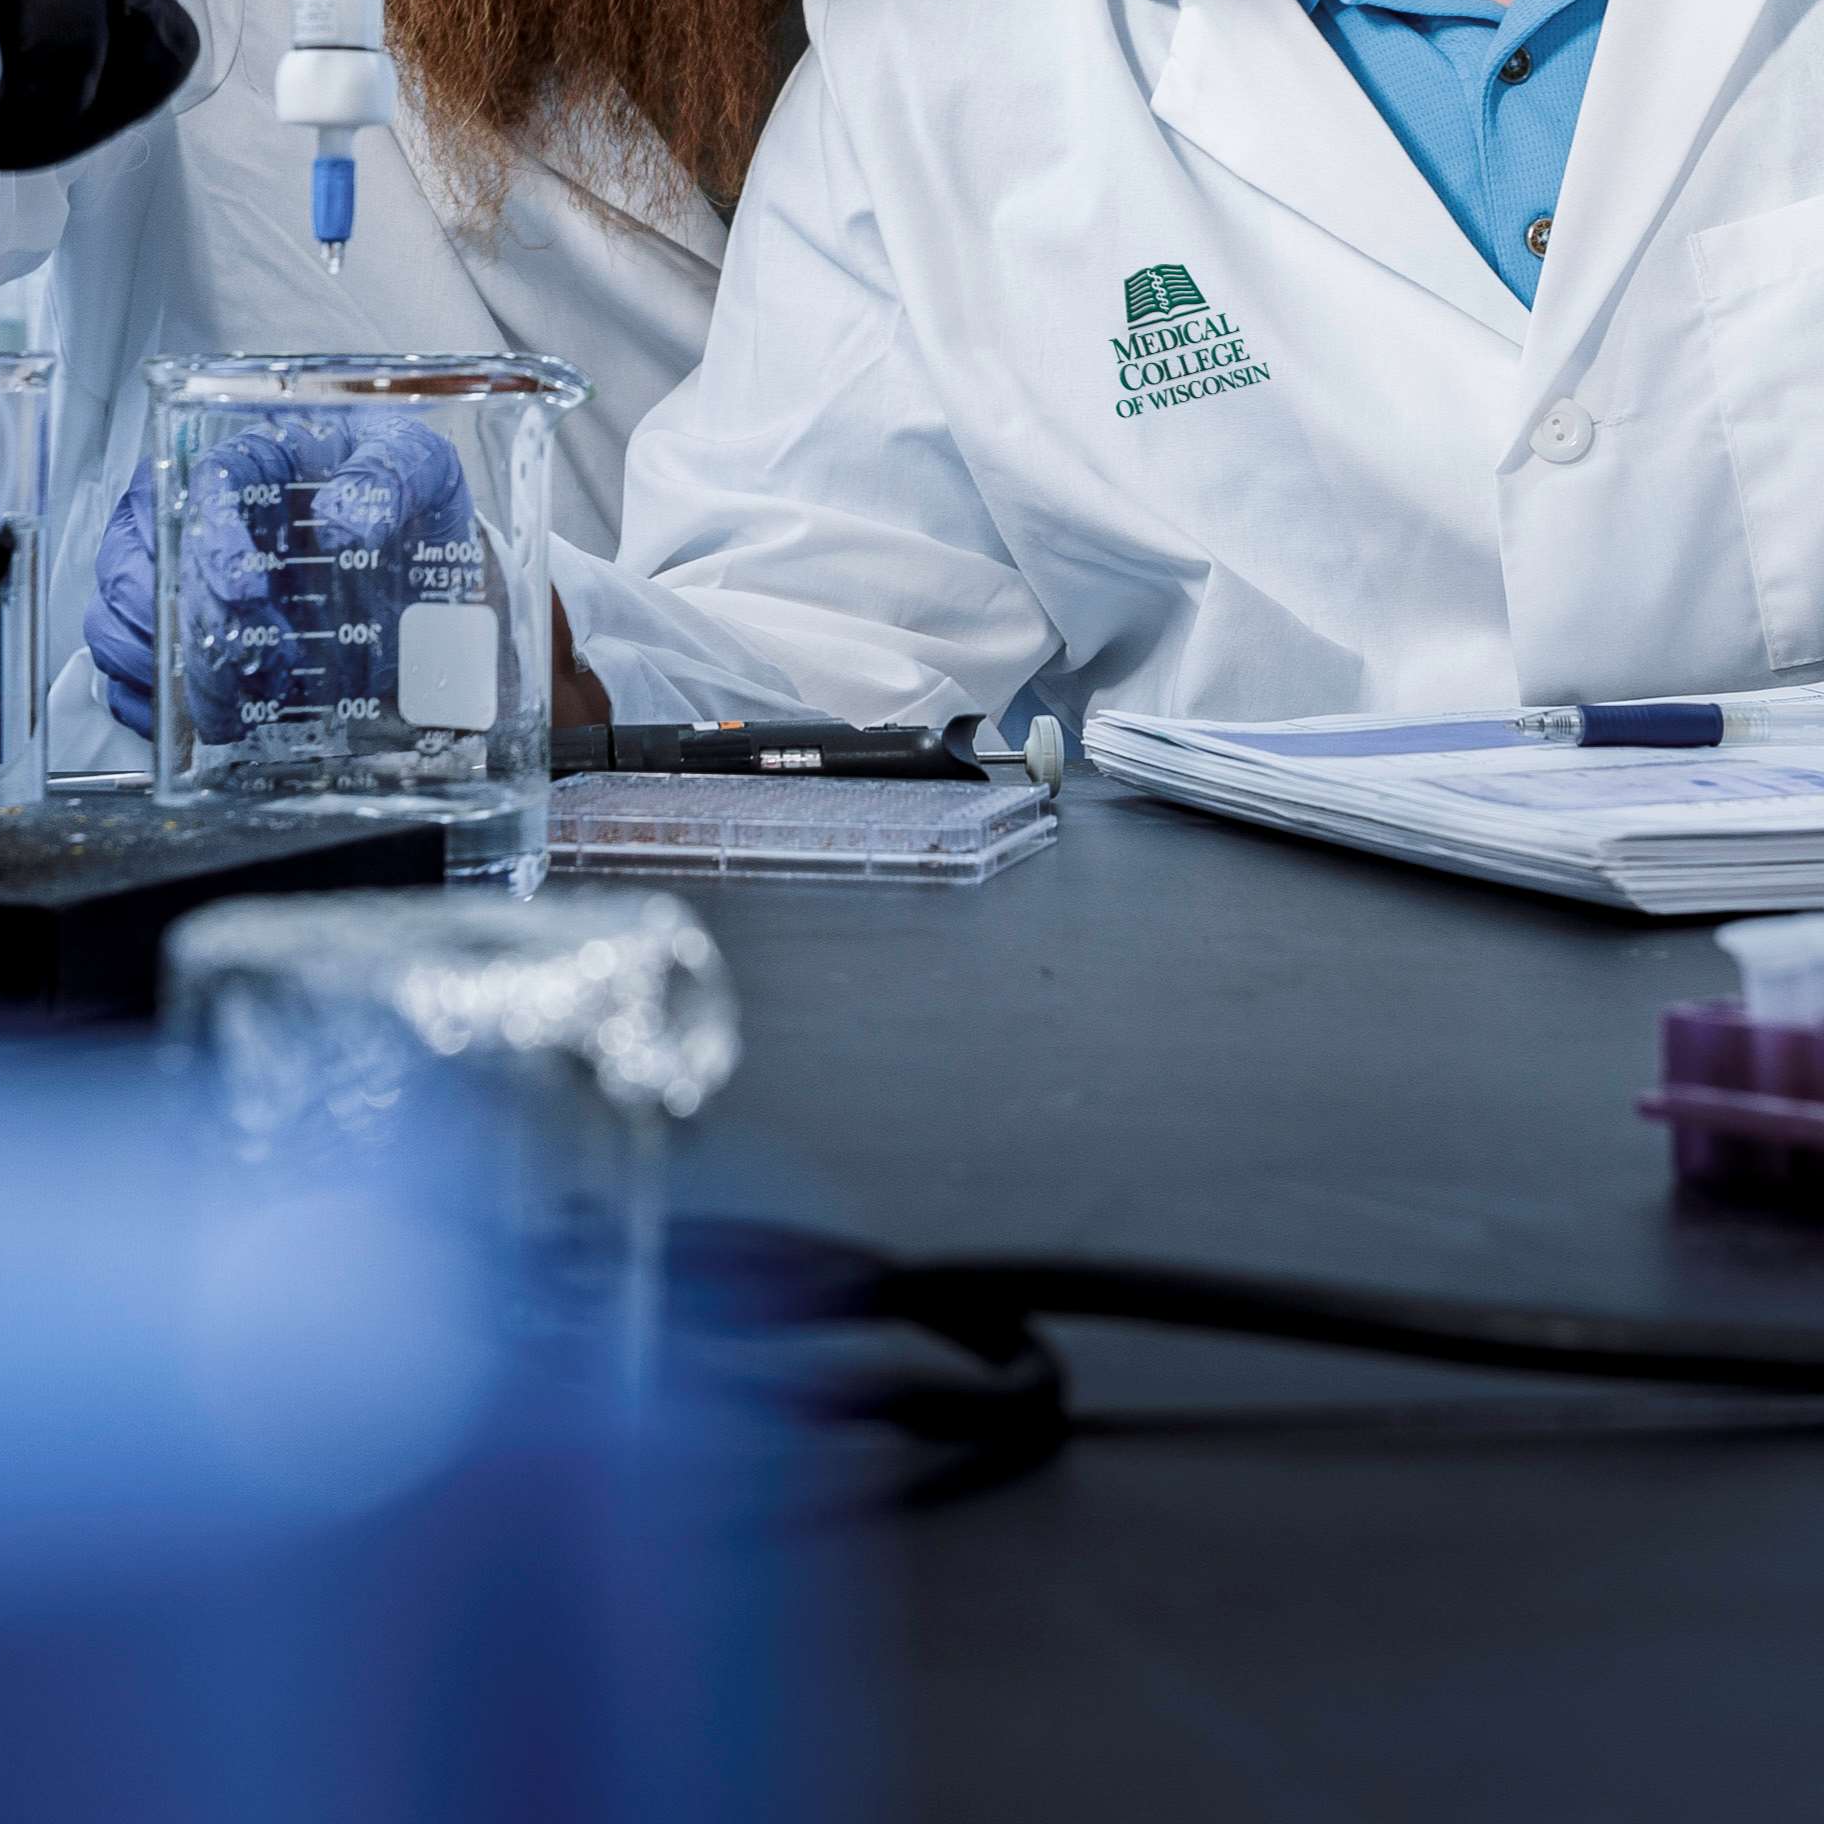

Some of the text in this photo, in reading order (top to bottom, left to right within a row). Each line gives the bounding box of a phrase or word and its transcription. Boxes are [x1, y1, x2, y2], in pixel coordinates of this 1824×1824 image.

[1109, 312, 1240, 364] MEDICAL
[1119, 338, 1251, 392] COLLEGE
[1115, 361, 1272, 419] OF WISCONSIN
